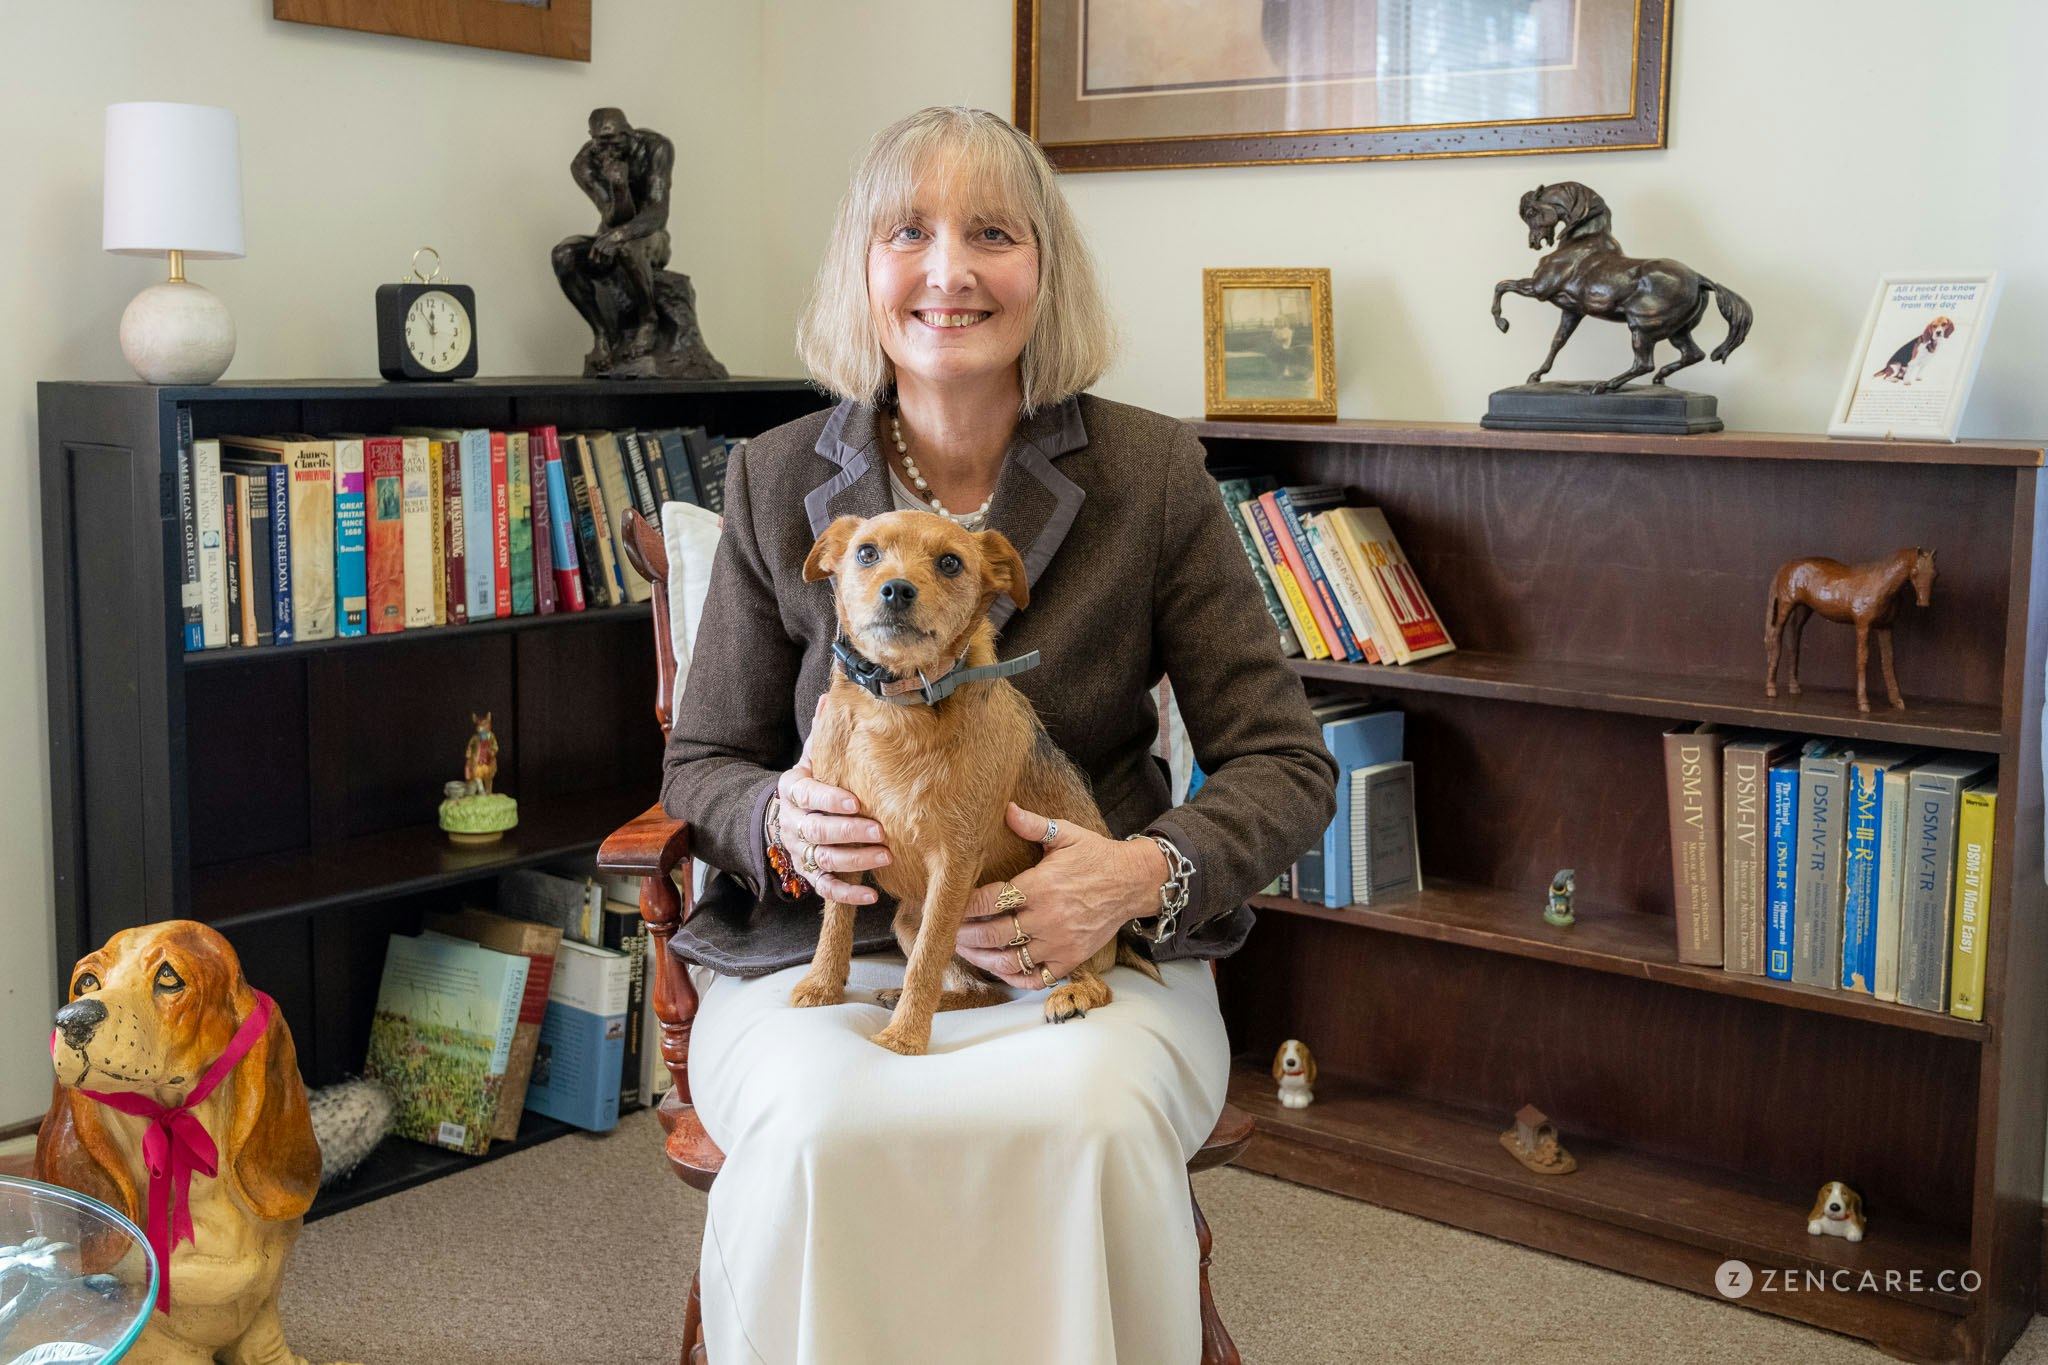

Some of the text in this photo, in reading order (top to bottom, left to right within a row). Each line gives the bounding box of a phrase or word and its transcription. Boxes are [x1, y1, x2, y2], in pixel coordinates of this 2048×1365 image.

[426, 298, 436, 309] 12
[1893, 294, 1918, 302] about
[1939, 302, 1957, 310] dog
[415, 302, 424, 313] 11
[441, 303, 446, 312] 1
[449, 313, 455, 323] 2
[405, 327, 412, 337] 9
[453, 327, 459, 337] 3
[409, 341, 416, 351] 8
[450, 342, 456, 351] 4
[418, 352, 424, 361] 7
[430, 356, 437, 365] 6
[442, 352, 448, 361] 5
[297, 450, 329, 459] James
[371, 444, 402, 458] PETER
[626, 432, 645, 473] PATRICIA
[370, 458, 403, 473] GREAT
[431, 458, 438, 466] A
[295, 470, 331, 481] WHIRLWIND
[181, 455, 192, 520] AMERICAN
[199, 447, 210, 529] AND THE MIND
[209, 465, 219, 511] HEALING
[533, 454, 550, 529] DESTINY
[635, 469, 656, 516] CORNWELL
[340, 501, 363, 509] GREAT
[432, 499, 440, 512] OF
[337, 510, 365, 519] BRITAIN
[275, 471, 289, 592] TRACKING FREEDOM
[341, 519, 363, 528] SINCE
[451, 496, 465, 558] HOUSEMENDING
[497, 483, 508, 568] FIRST YEAR LATIN
[433, 512, 441, 554] ENGLAND
[185, 524, 199, 609] CORRECTS
[208, 551, 217, 568] BILL
[1681, 744, 1704, 830] DSM-IV
[1736, 763, 1757, 848] DSM-IV
[1773, 782, 1783, 838] Interview Using
[1781, 781, 1791, 825] The Clinical
[1810, 784, 1829, 872] DSM-IV-TR
[1919, 801, 1939, 891] DSM-IV-TR
[1776, 841, 1788, 890] DSM-III-R
[1959, 843, 1981, 954] DSM-IV Made Easy
[1772, 901, 1782, 929] Othmer
[1779, 901, 1788, 929] Othmer
[621, 935, 631, 952] OF
[1779, 930, 1788, 945] and
[634, 919, 645, 1003] METROPOLITAN
[508, 968, 524, 1024] PIONEER
[501, 1027, 512, 1057] GIRL
